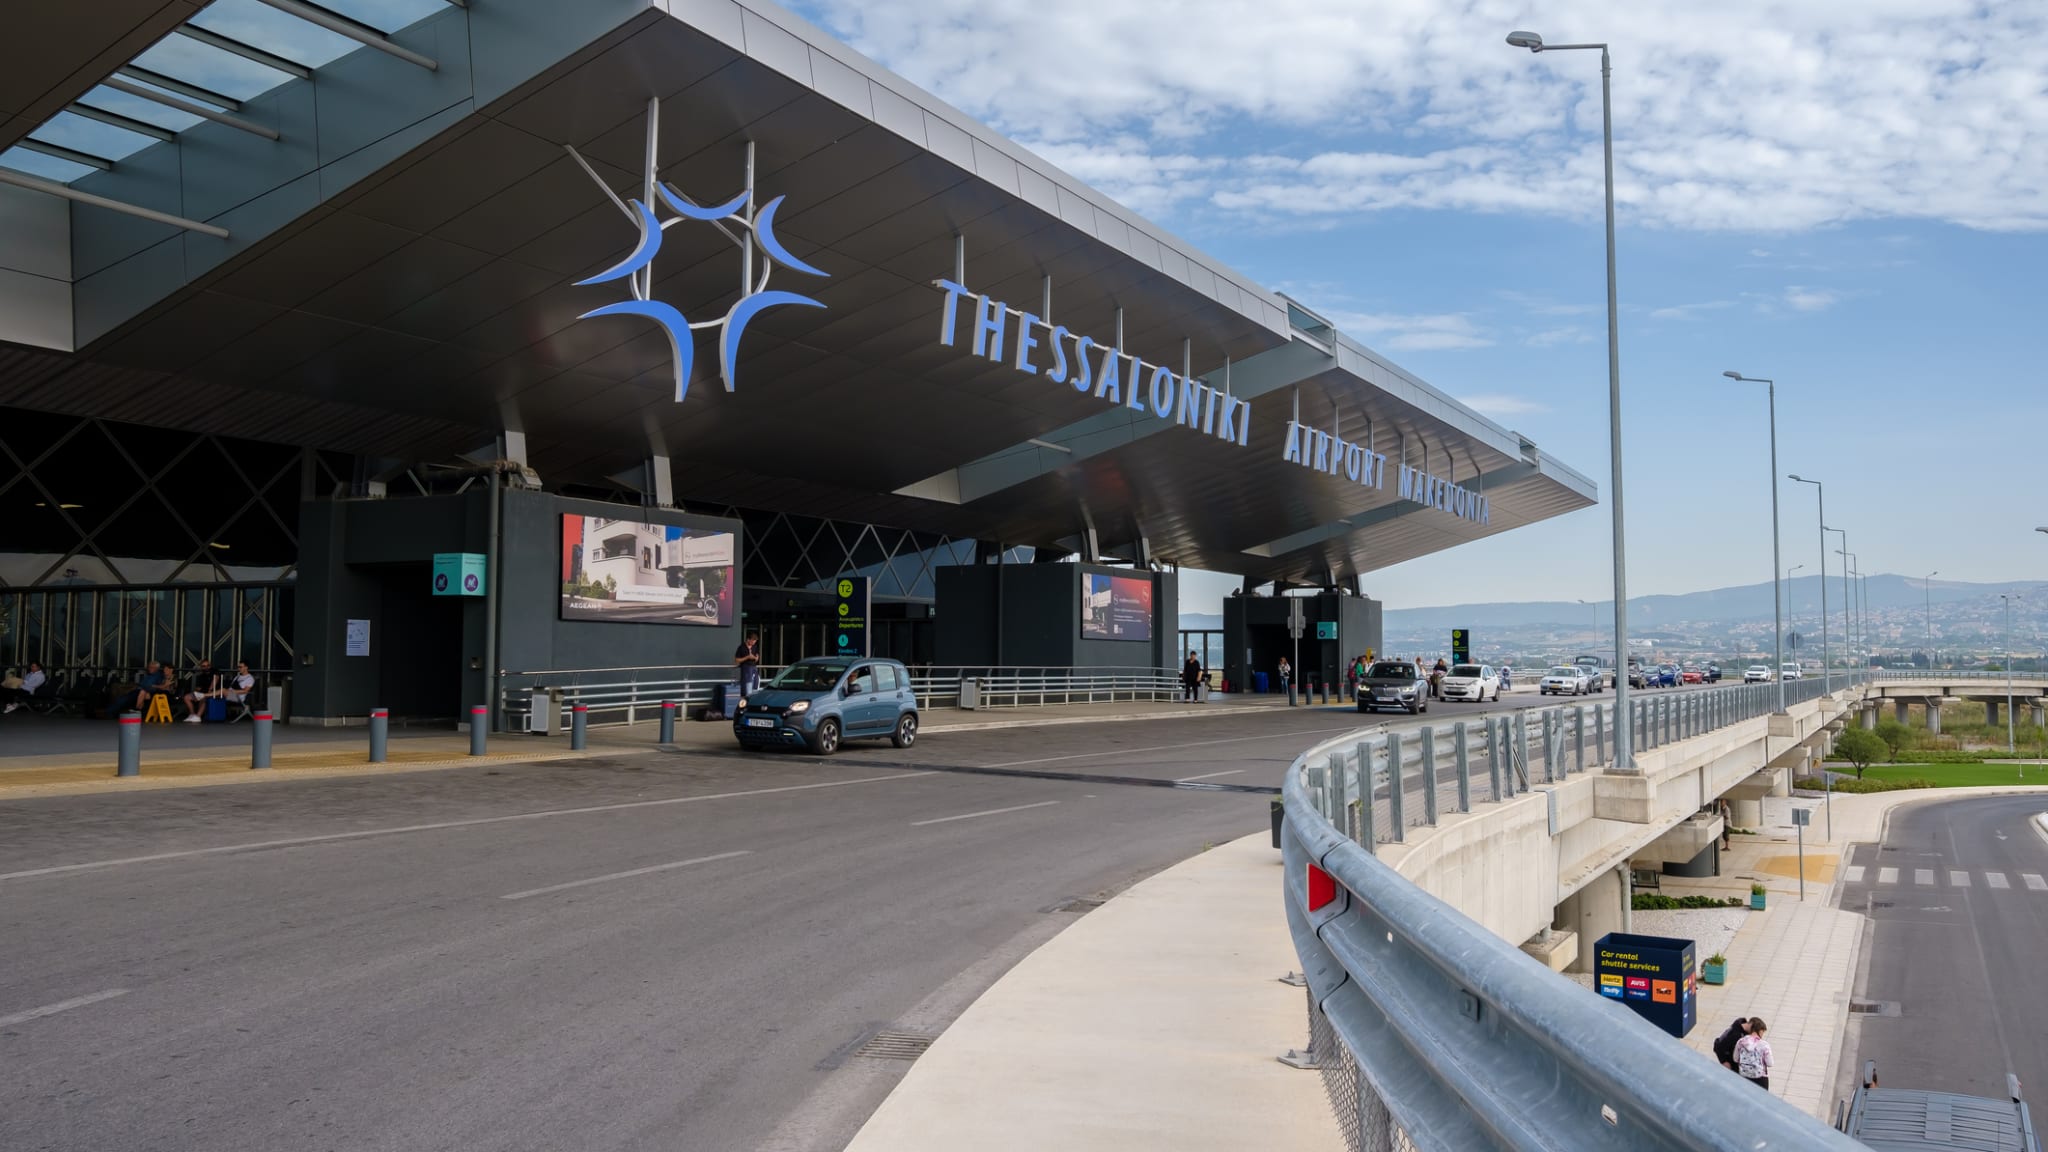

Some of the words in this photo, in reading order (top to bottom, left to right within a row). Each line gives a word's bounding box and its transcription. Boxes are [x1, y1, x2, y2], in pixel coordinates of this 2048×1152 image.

[931, 278, 1250, 447] THESSALONIKI
[1283, 420, 1387, 490] AIRPORT
[1396, 463, 1490, 526] MAKEDONIA
[840, 584, 851, 593] T2
[1601, 950, 1615, 958] Car
[1615, 952, 1639, 961] rental
[1601, 960, 1628, 969] shuttle
[1628, 963, 1660, 972] services
